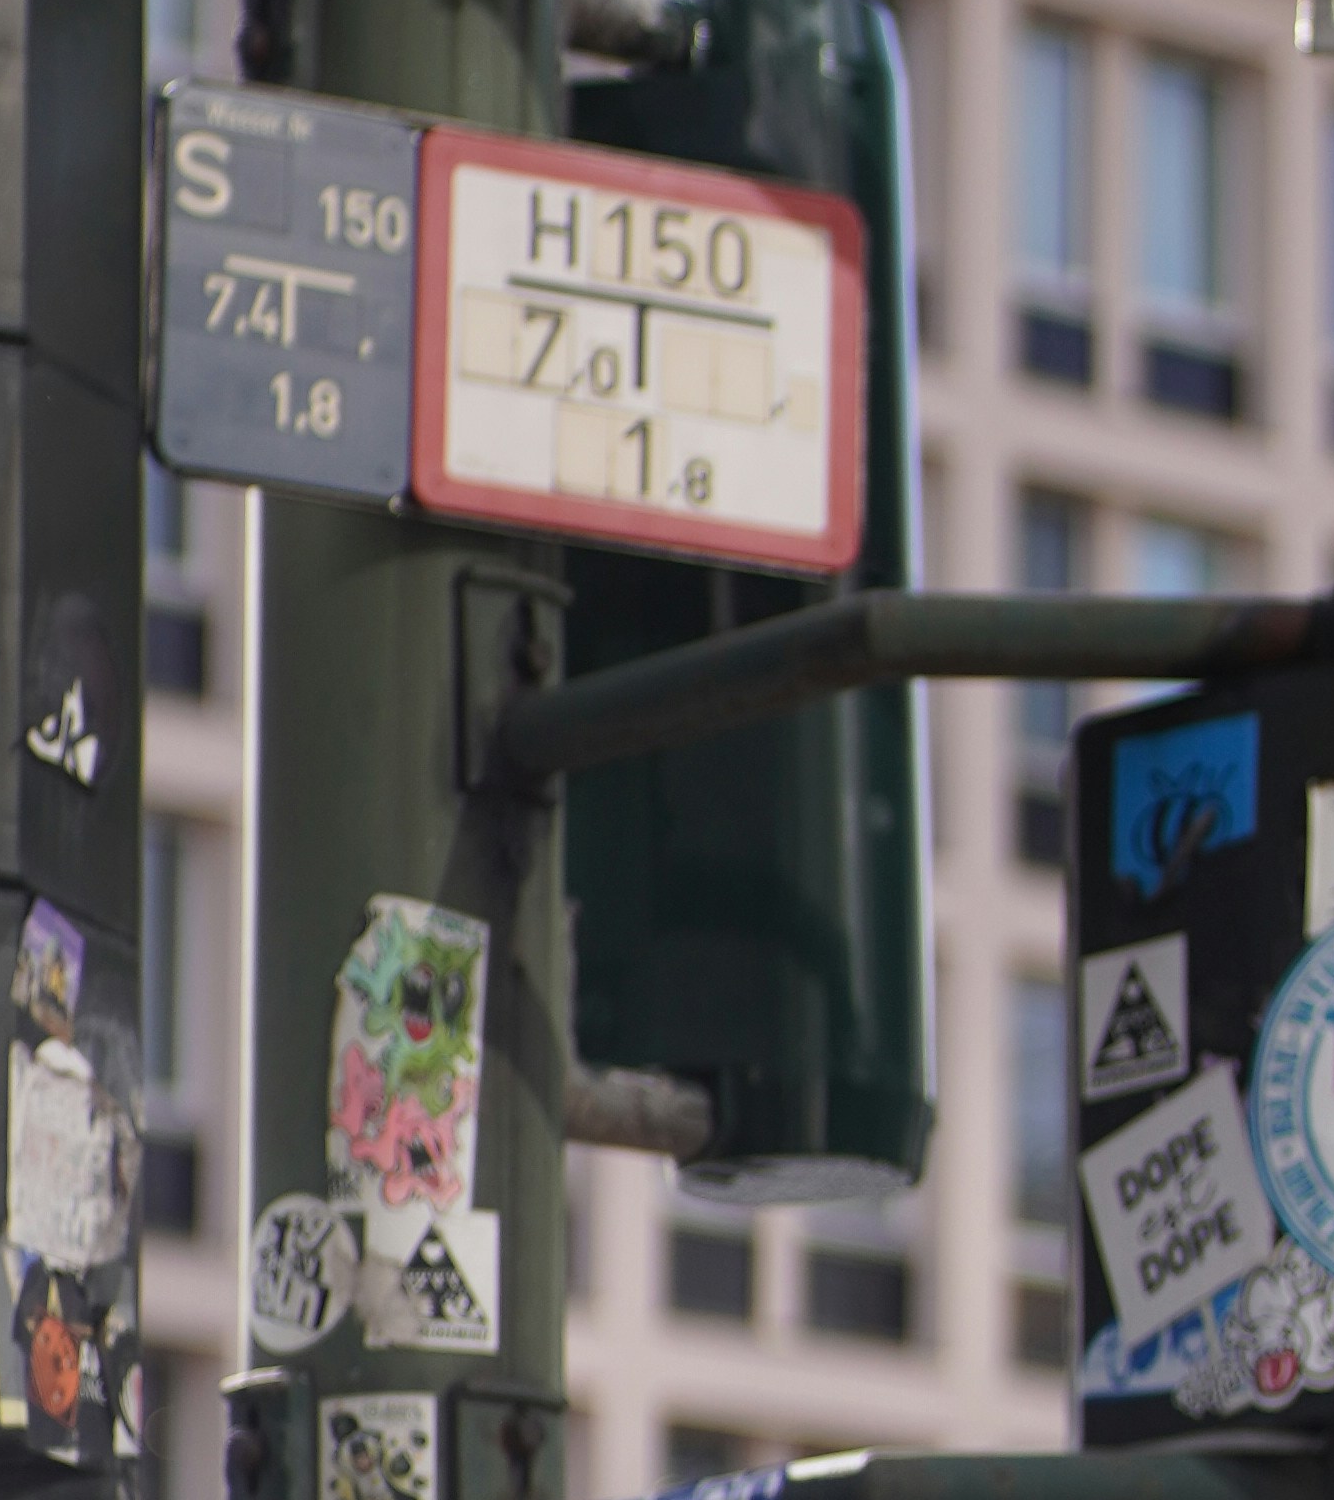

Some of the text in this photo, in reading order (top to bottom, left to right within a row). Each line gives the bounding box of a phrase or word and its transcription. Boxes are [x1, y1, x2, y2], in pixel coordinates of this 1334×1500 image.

[175, 130, 231, 217] S
[319, 184, 411, 252] 150
[528, 187, 751, 298] H150
[1114, 1114, 1220, 1211] DOPE
[1136, 1200, 1242, 1295] DOPE
